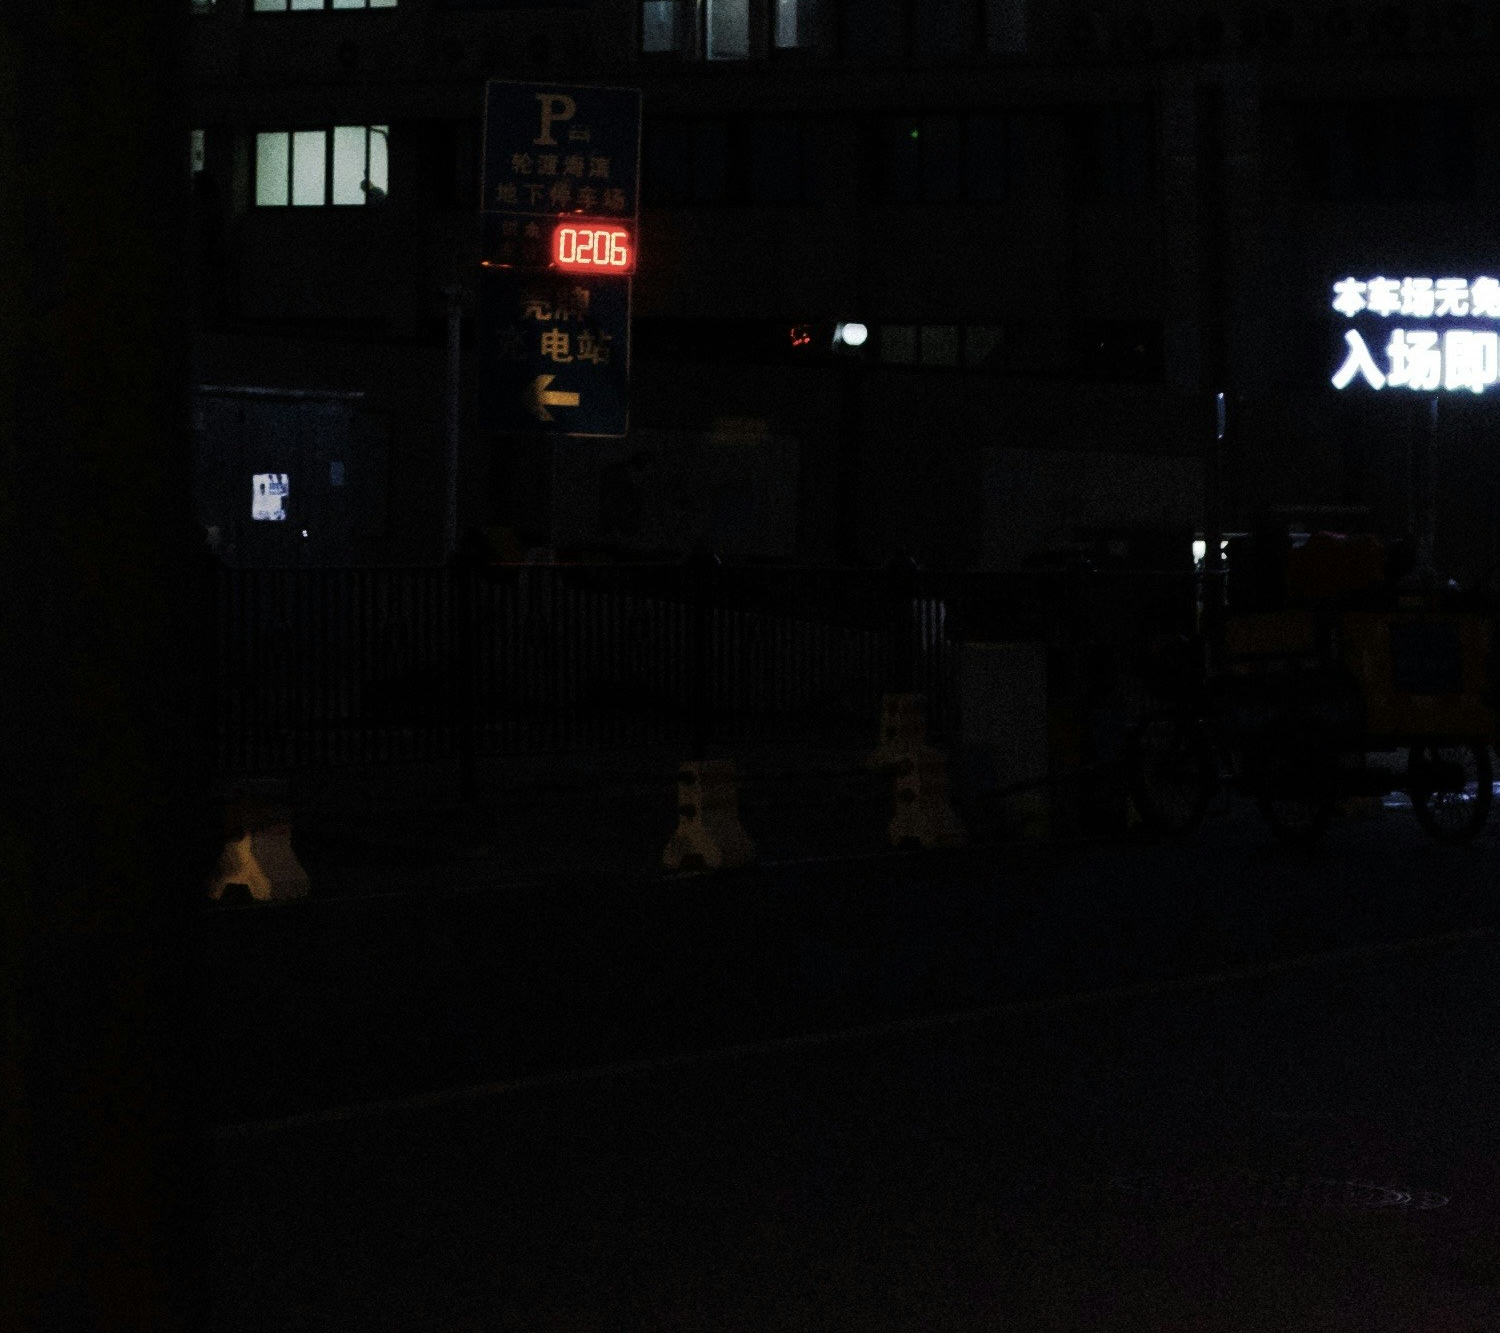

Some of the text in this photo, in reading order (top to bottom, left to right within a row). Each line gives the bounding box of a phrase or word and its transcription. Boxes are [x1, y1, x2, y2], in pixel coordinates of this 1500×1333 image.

[533, 92, 577, 146] P
[495, 176, 626, 211] 地下停车场
[557, 227, 628, 267] 0206
